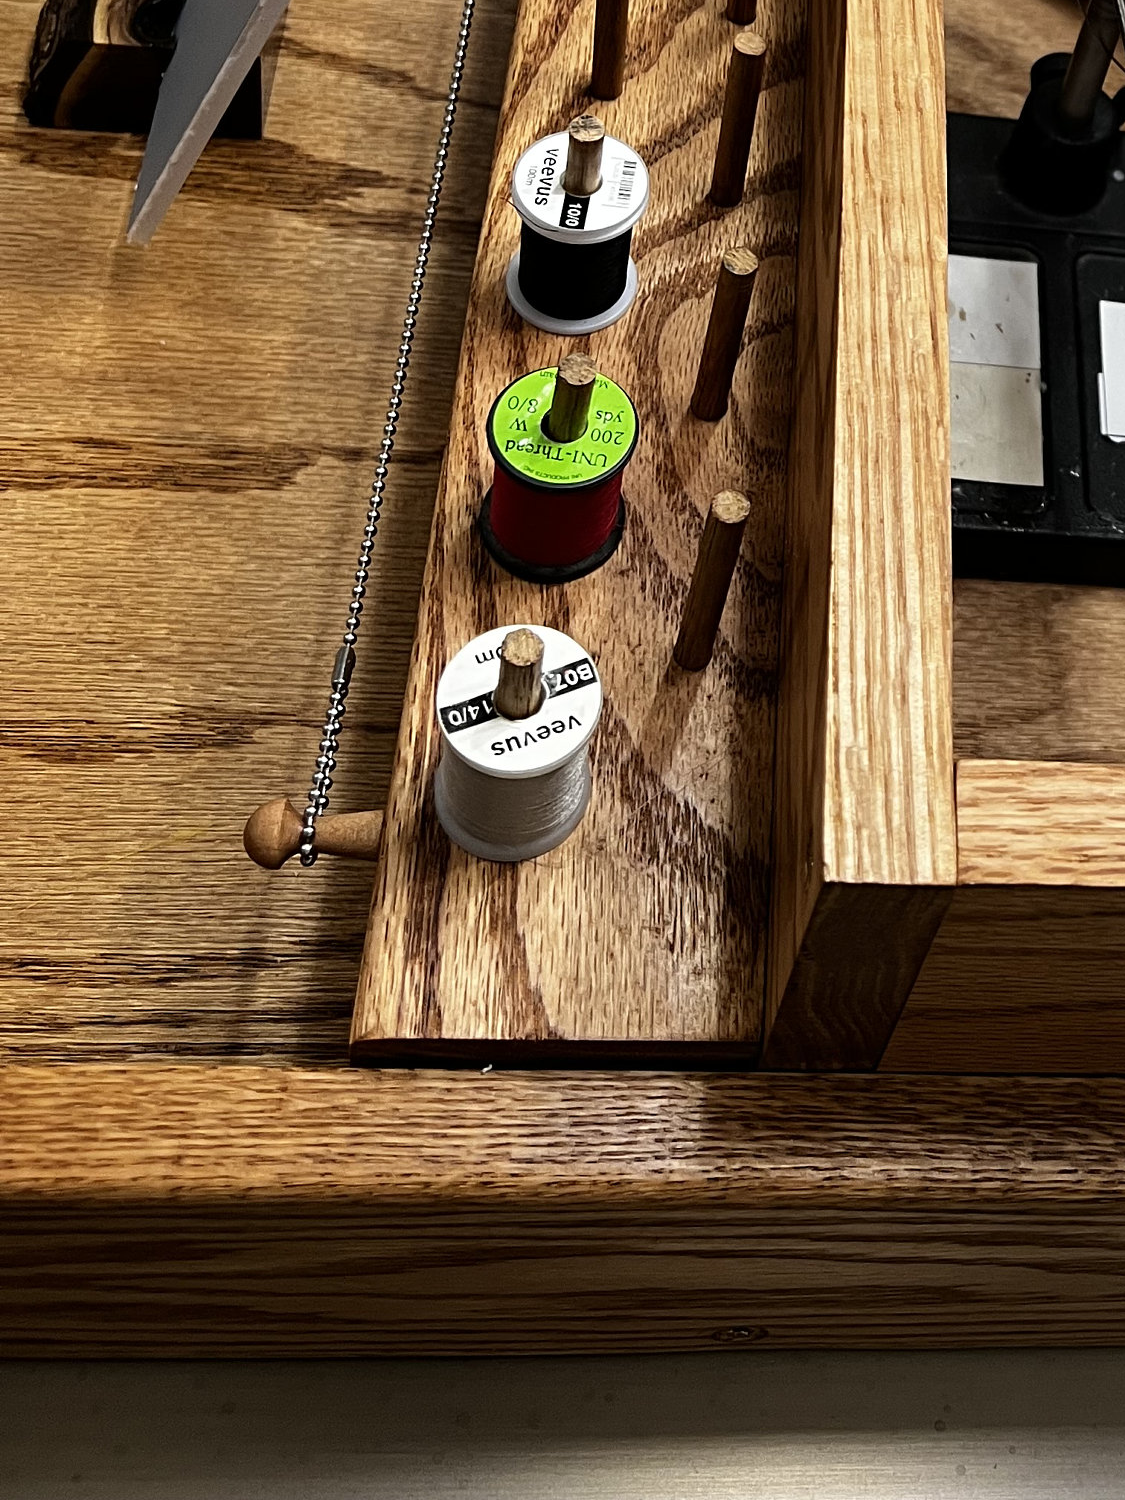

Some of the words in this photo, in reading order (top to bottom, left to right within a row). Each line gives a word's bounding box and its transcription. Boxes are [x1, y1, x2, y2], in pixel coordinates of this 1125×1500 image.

[526, 165, 538, 186] 100m
[534, 148, 559, 206] veevus
[565, 203, 583, 227] 10/0
[507, 394, 539, 414] 8/0
[595, 410, 625, 423] yds
[590, 428, 625, 445] 200
[505, 439, 608, 468] UNI-Thread
[449, 700, 493, 726] 14/0
[491, 715, 582, 756] veevus
